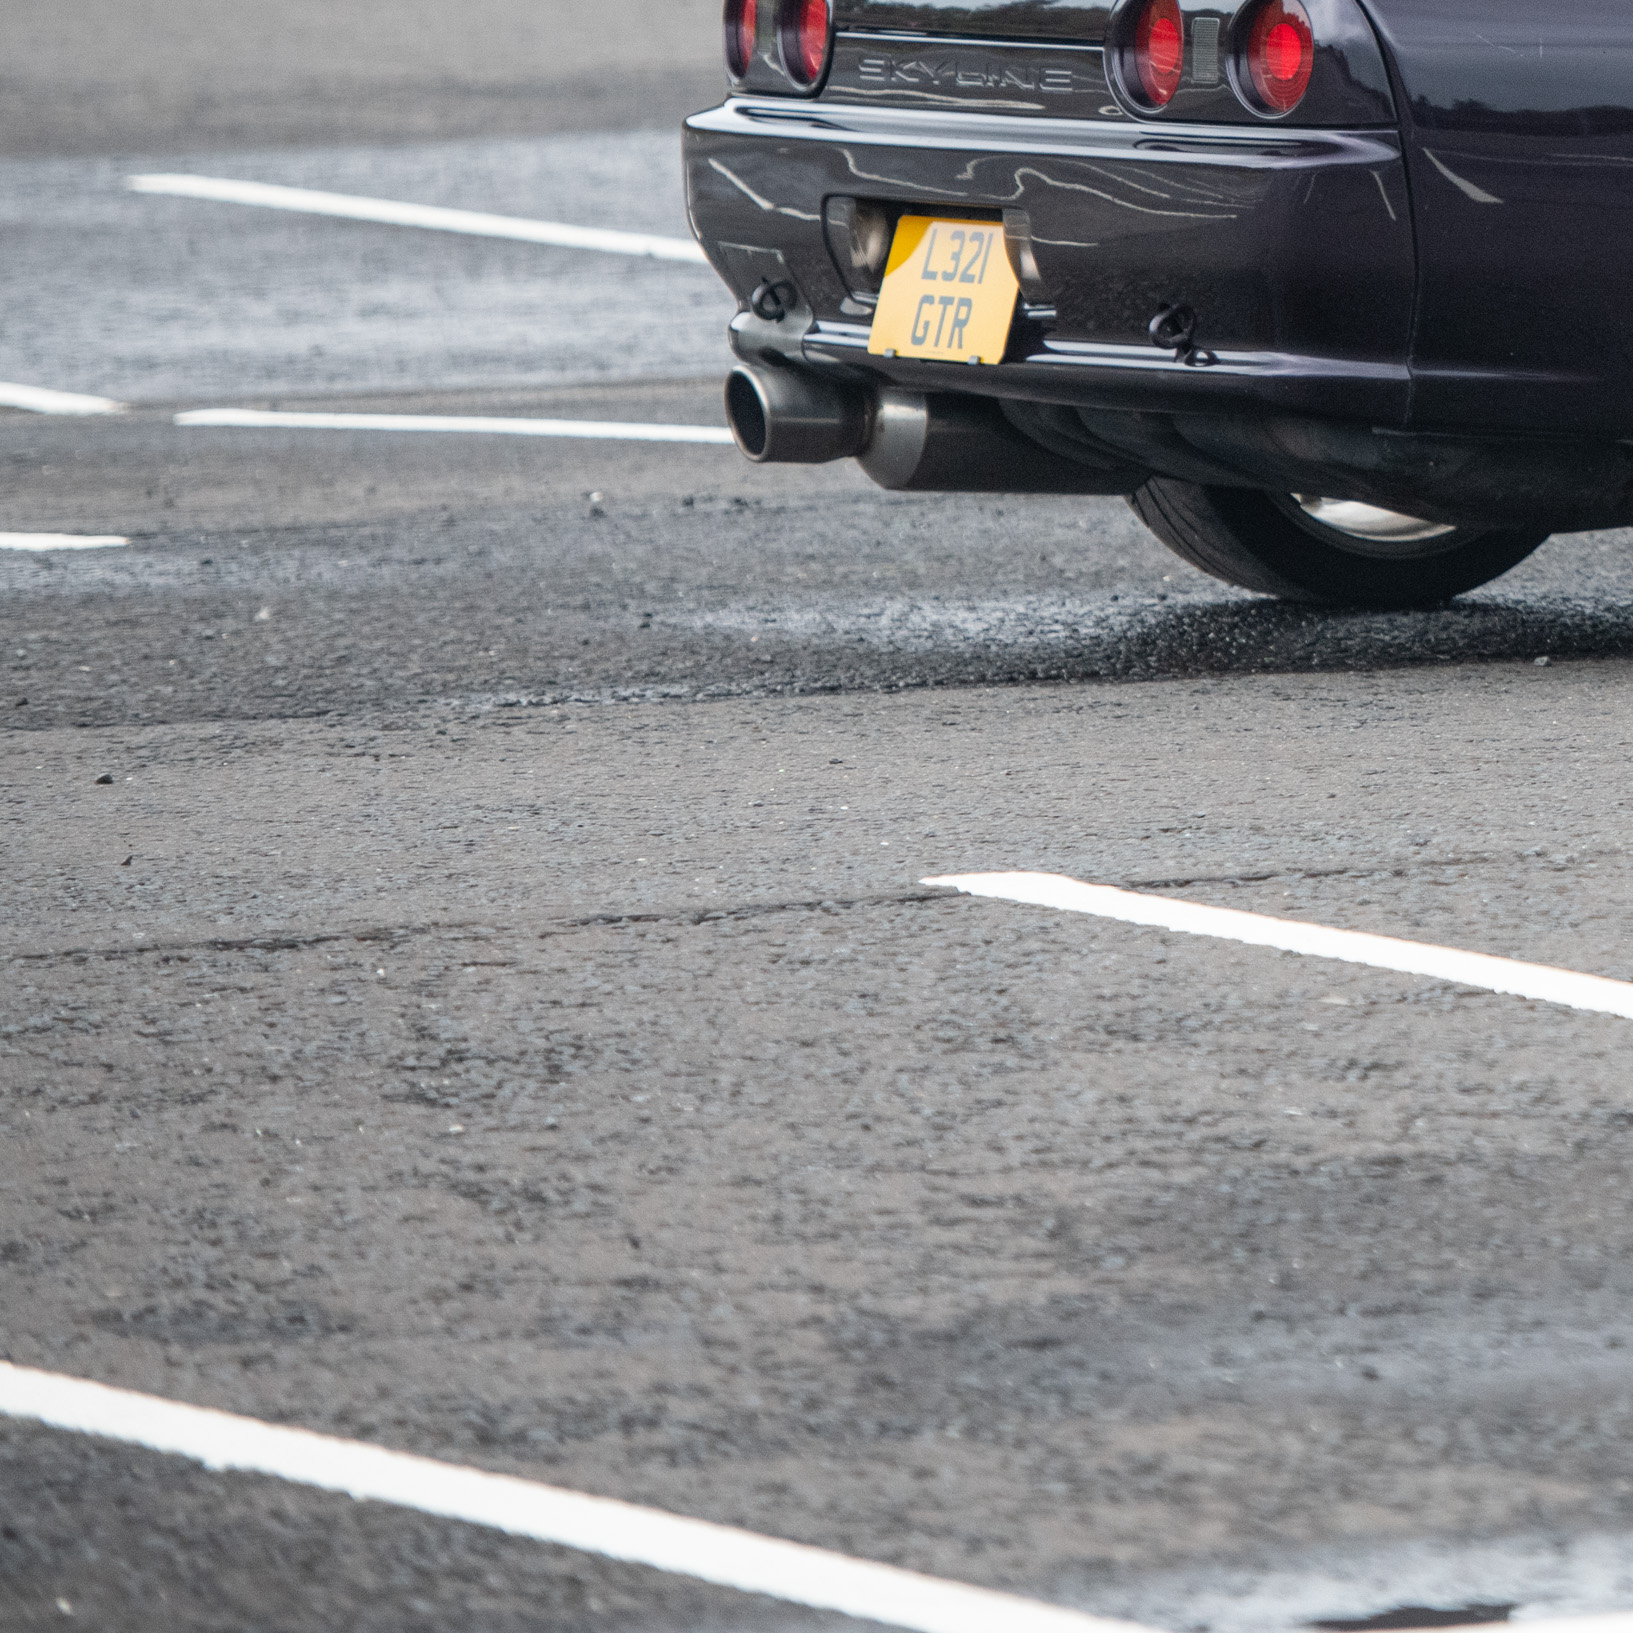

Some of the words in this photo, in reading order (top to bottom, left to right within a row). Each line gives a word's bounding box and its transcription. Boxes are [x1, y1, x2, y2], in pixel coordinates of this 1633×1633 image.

[858, 58, 1073, 92] SKYLINE
[921, 228, 994, 285] L321
[911, 294, 973, 350] GTR
